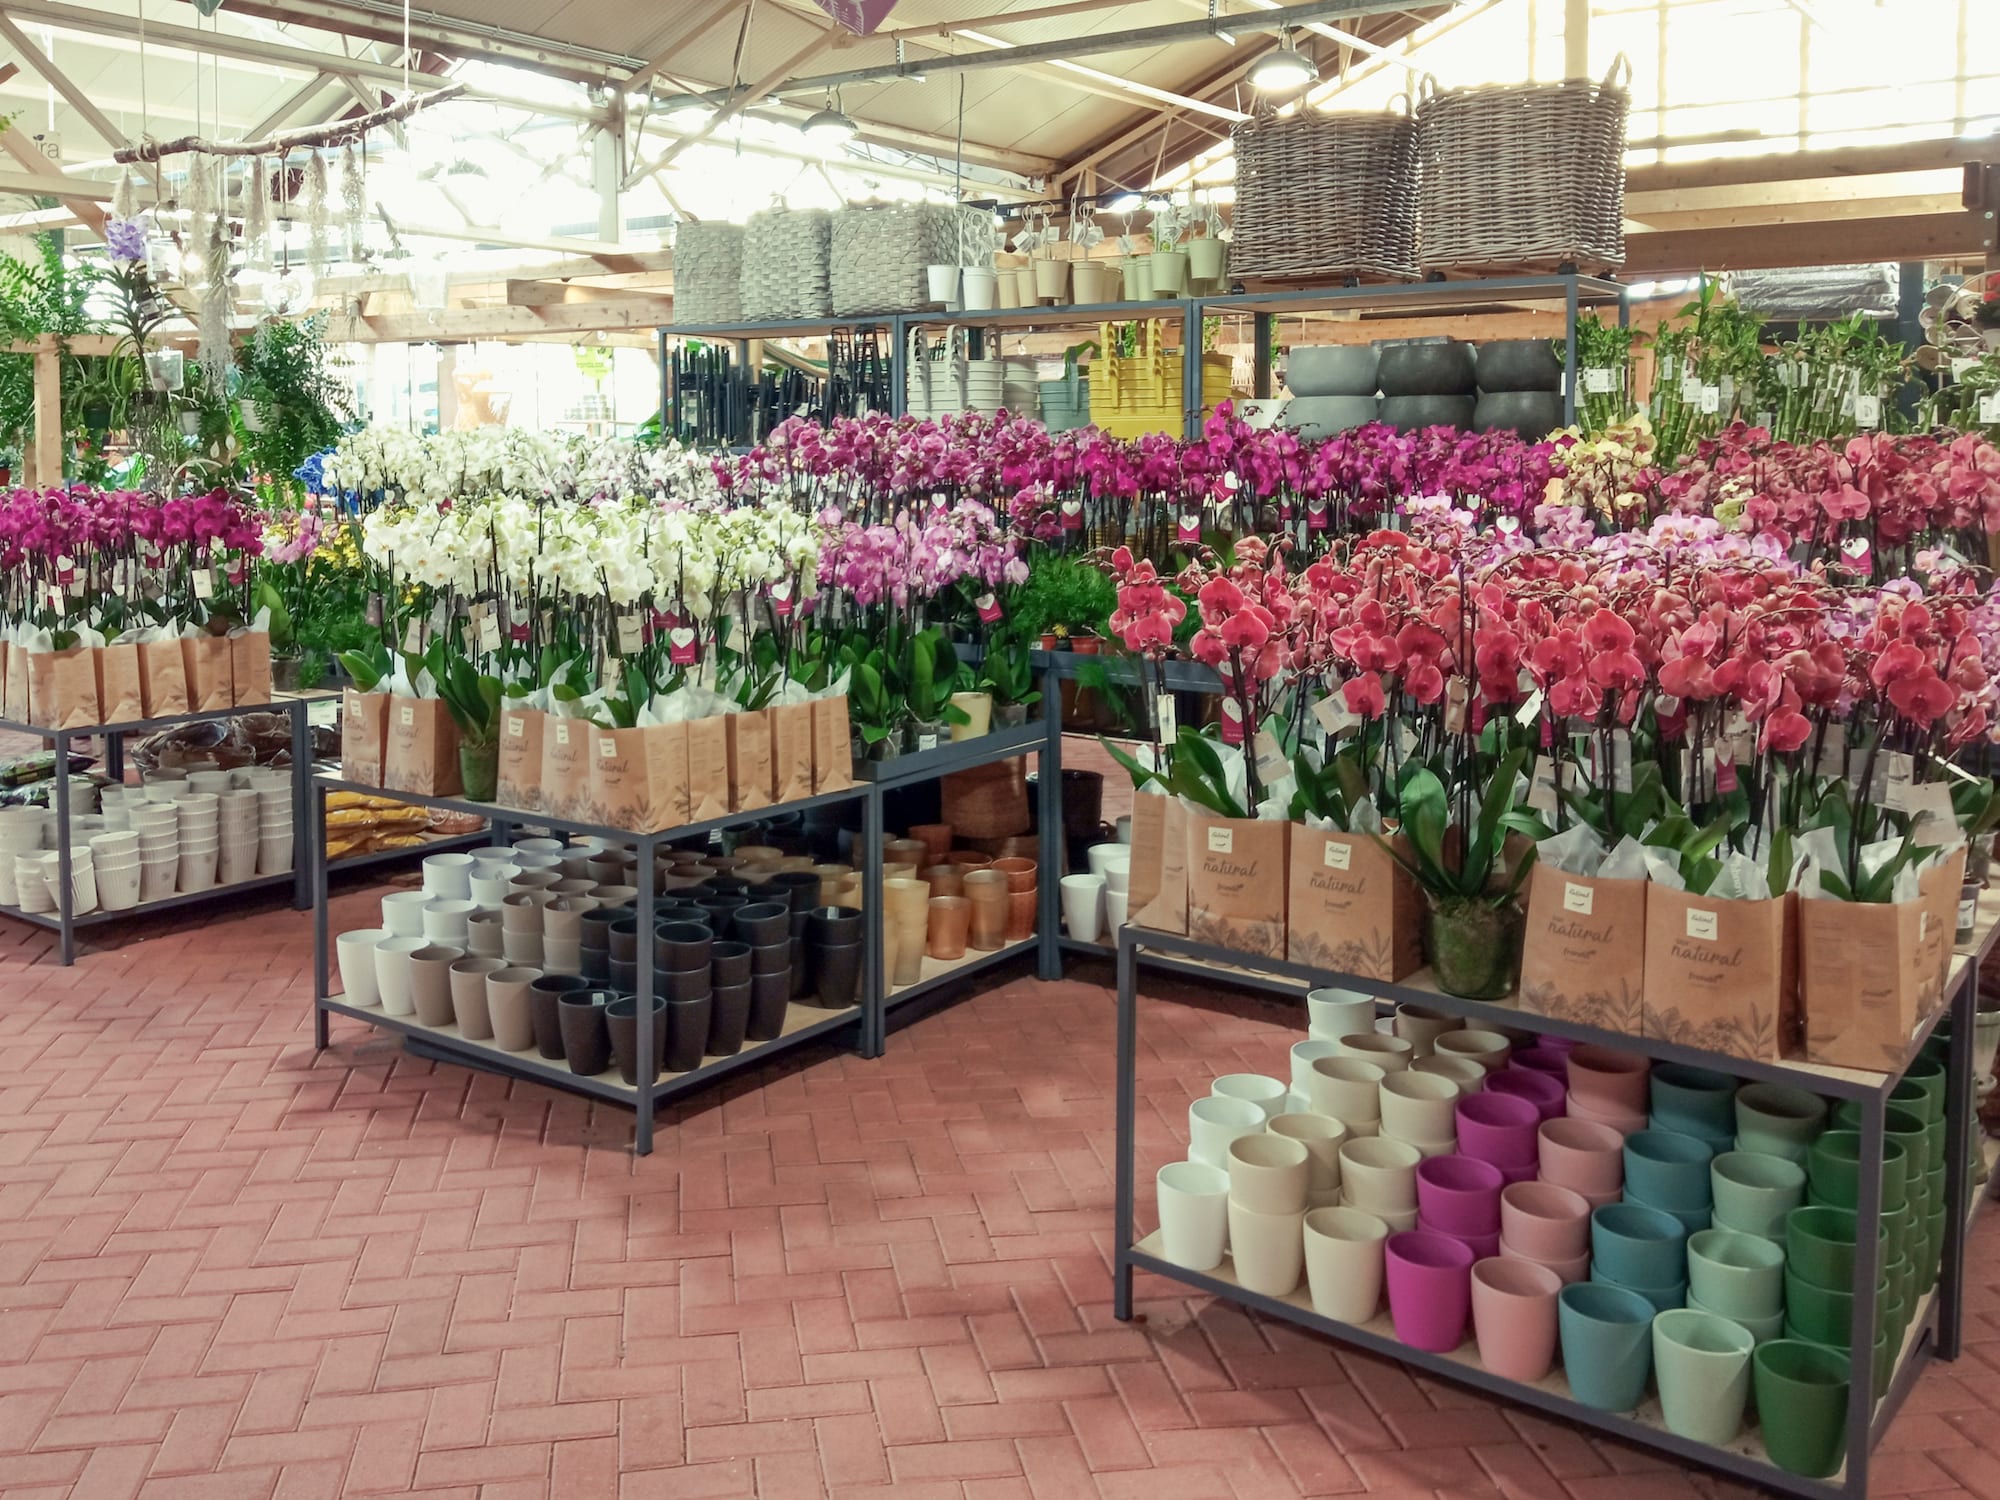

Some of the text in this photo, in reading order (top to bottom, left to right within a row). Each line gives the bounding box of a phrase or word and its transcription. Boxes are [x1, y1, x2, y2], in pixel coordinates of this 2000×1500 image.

[1203, 859, 1258, 878] natural
[1310, 874, 1366, 895] natural
[1547, 920, 1614, 944] natural
[1671, 944, 1743, 967] natural
